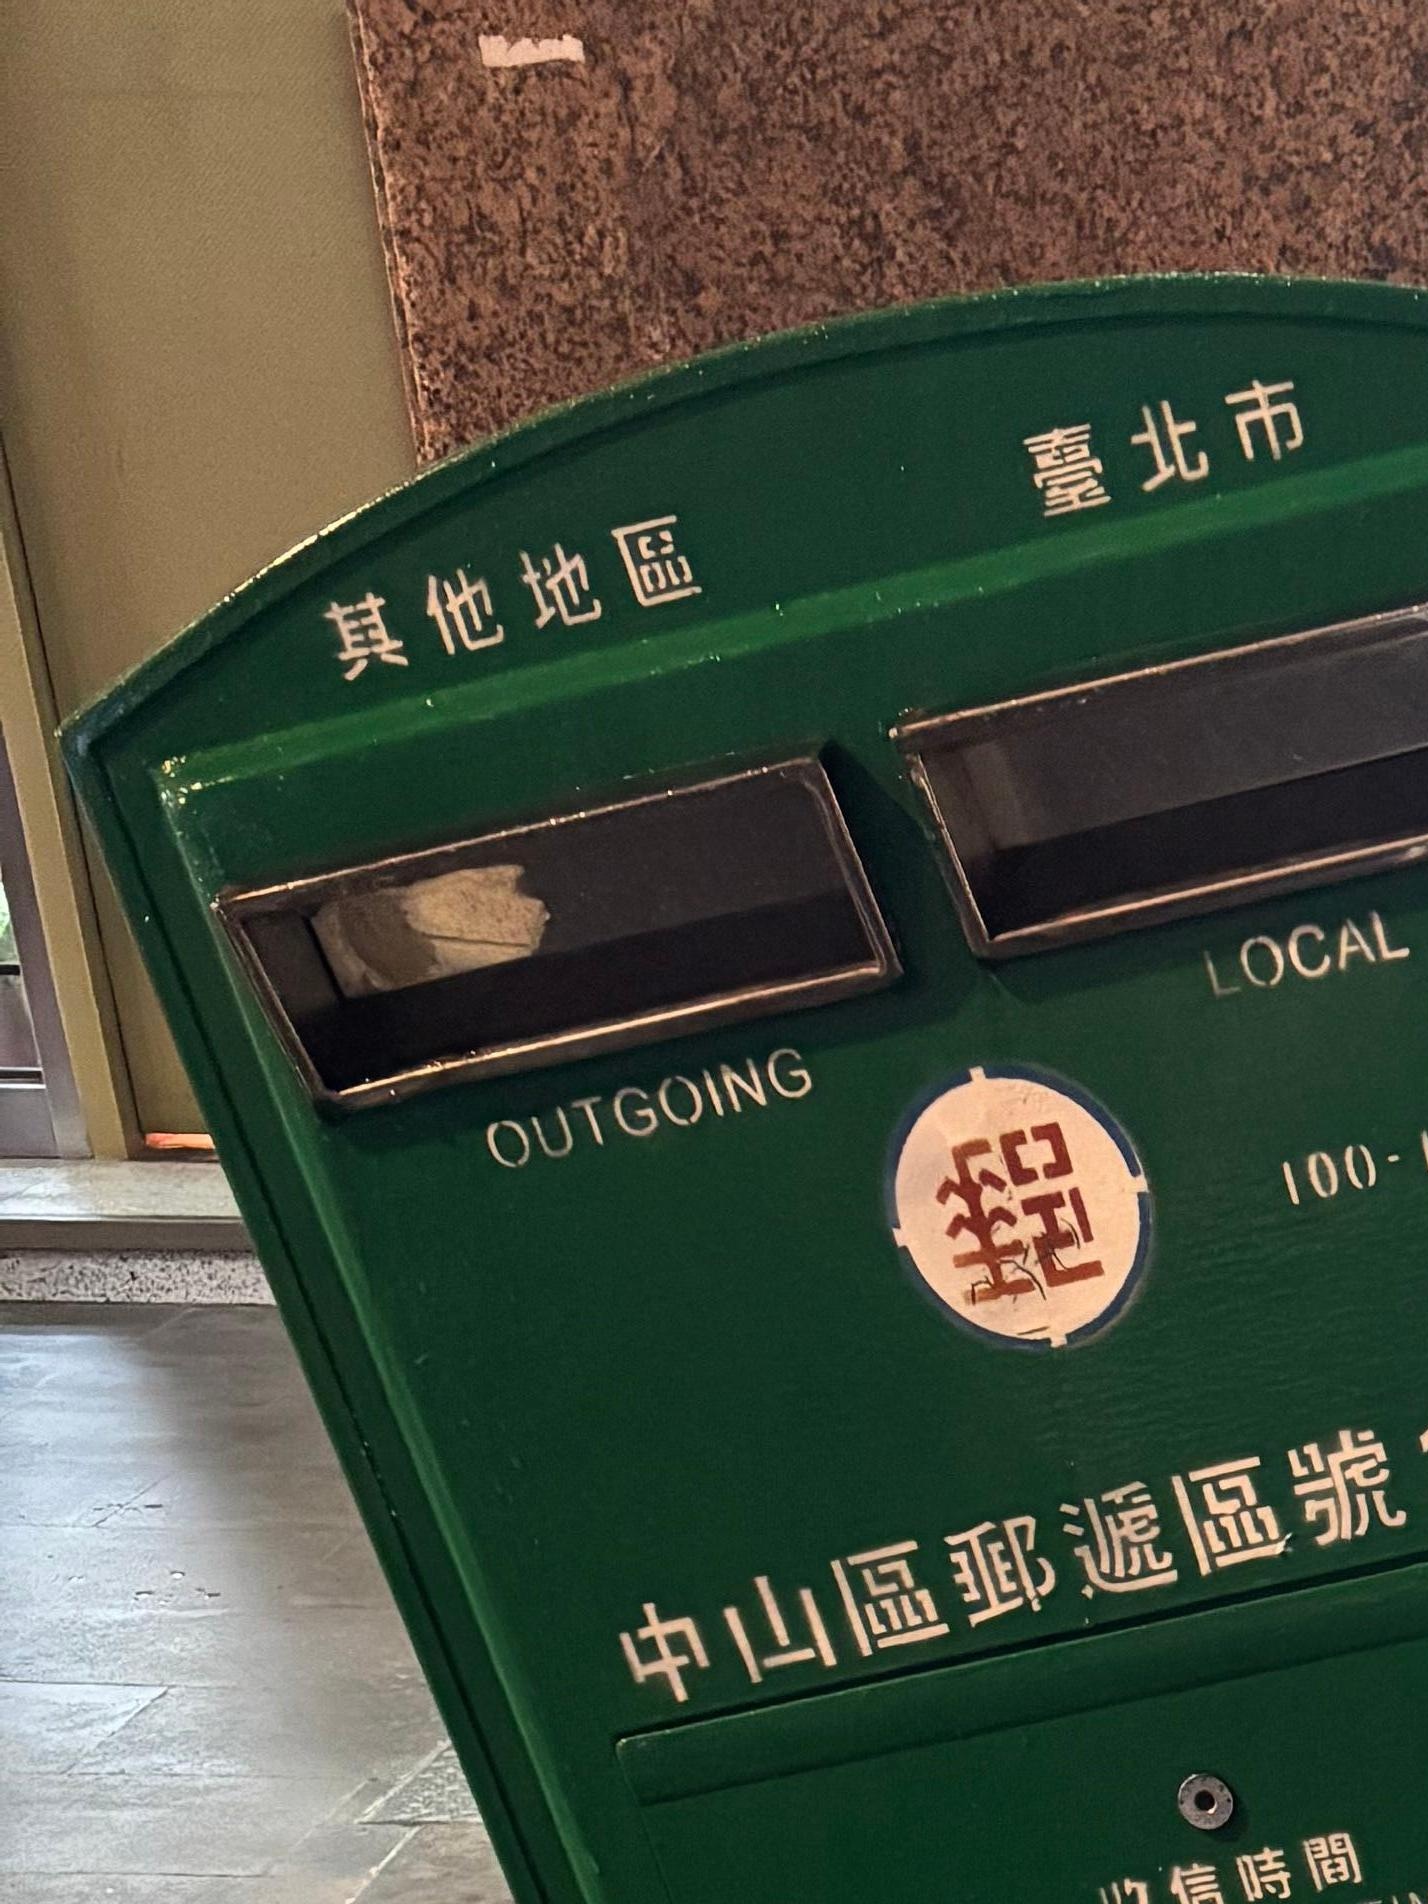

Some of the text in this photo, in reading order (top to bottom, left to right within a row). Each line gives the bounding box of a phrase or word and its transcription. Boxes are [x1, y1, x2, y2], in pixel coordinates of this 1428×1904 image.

[1024, 381, 1303, 516] 臺北市
[325, 516, 701, 680] 其他地區
[1207, 912, 1410, 998] LOCAL
[486, 1048, 813, 1168] OUTGOING
